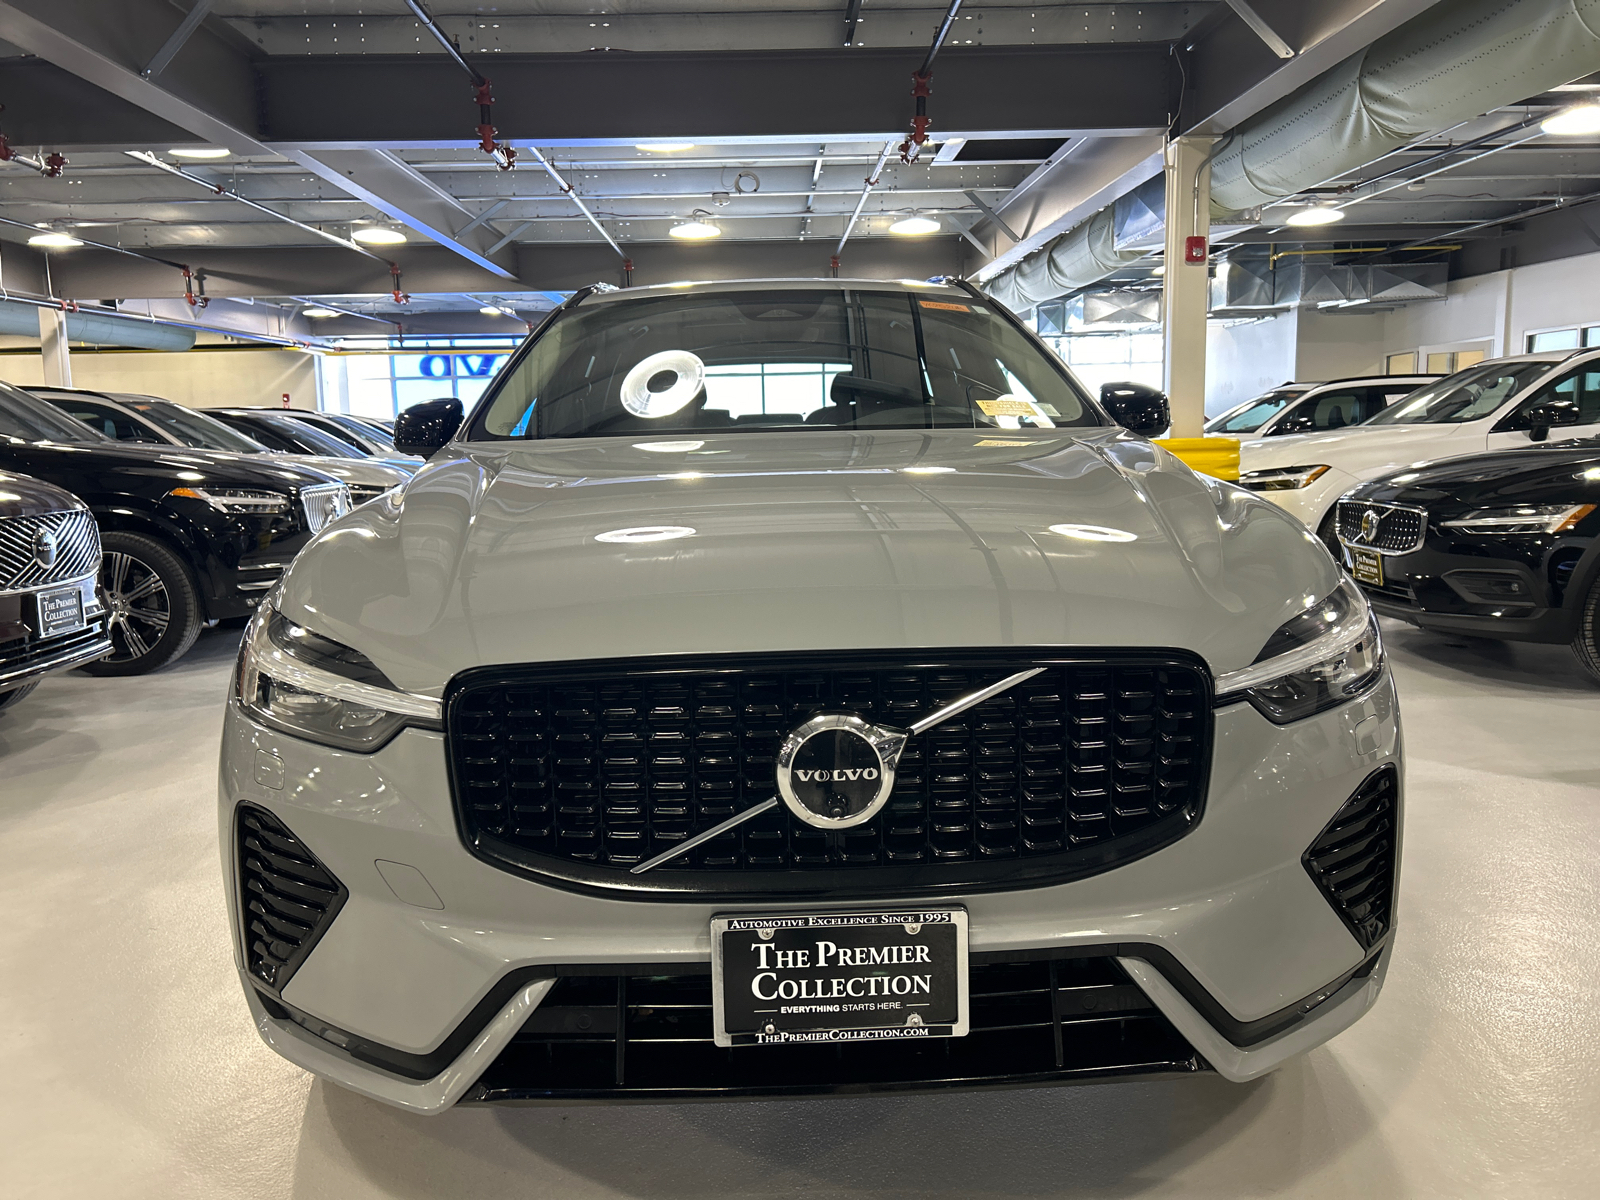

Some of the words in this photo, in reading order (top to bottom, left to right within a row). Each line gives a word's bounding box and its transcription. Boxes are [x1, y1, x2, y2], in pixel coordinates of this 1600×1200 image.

[43, 601, 56, 611] THE
[55, 598, 77, 609] PREMIER
[44, 607, 78, 621] COLLECTION
[794, 767, 878, 782] VOLVO
[730, 919, 805, 930] AUTOMOTIVE
[808, 916, 879, 927] EXCELLENCE
[881, 914, 915, 924] SINCE
[919, 913, 949, 923] 1995
[751, 942, 810, 970] THE
[815, 941, 932, 967] PREMIER
[751, 972, 932, 1000] COLLECTION
[781, 1004, 840, 1014] EVERYTHING
[842, 1003, 876, 1012] STARTS
